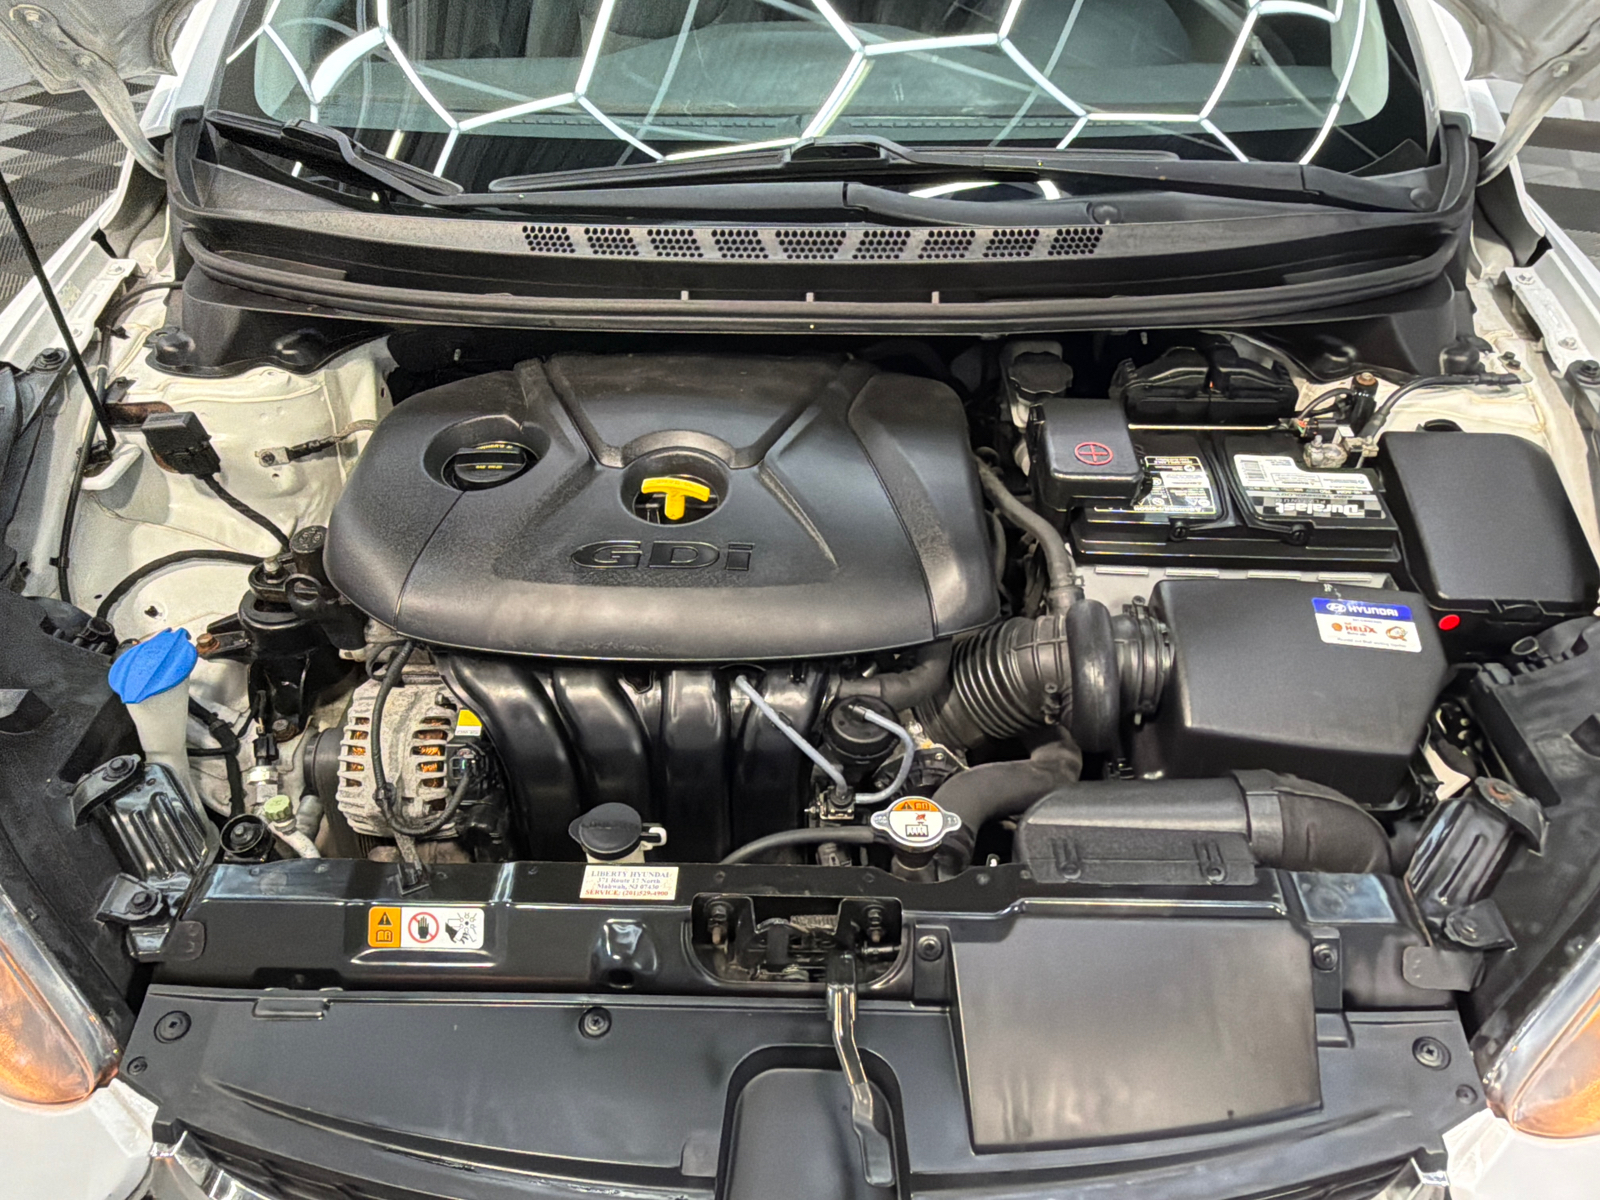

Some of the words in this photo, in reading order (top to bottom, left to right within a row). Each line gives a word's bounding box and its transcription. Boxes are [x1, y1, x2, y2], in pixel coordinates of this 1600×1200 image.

[1275, 502, 1365, 516] Duralast
[571, 539, 755, 571] GDi
[1348, 605, 1399, 617] HYUNDAI
[1345, 624, 1377, 634] HELIX
